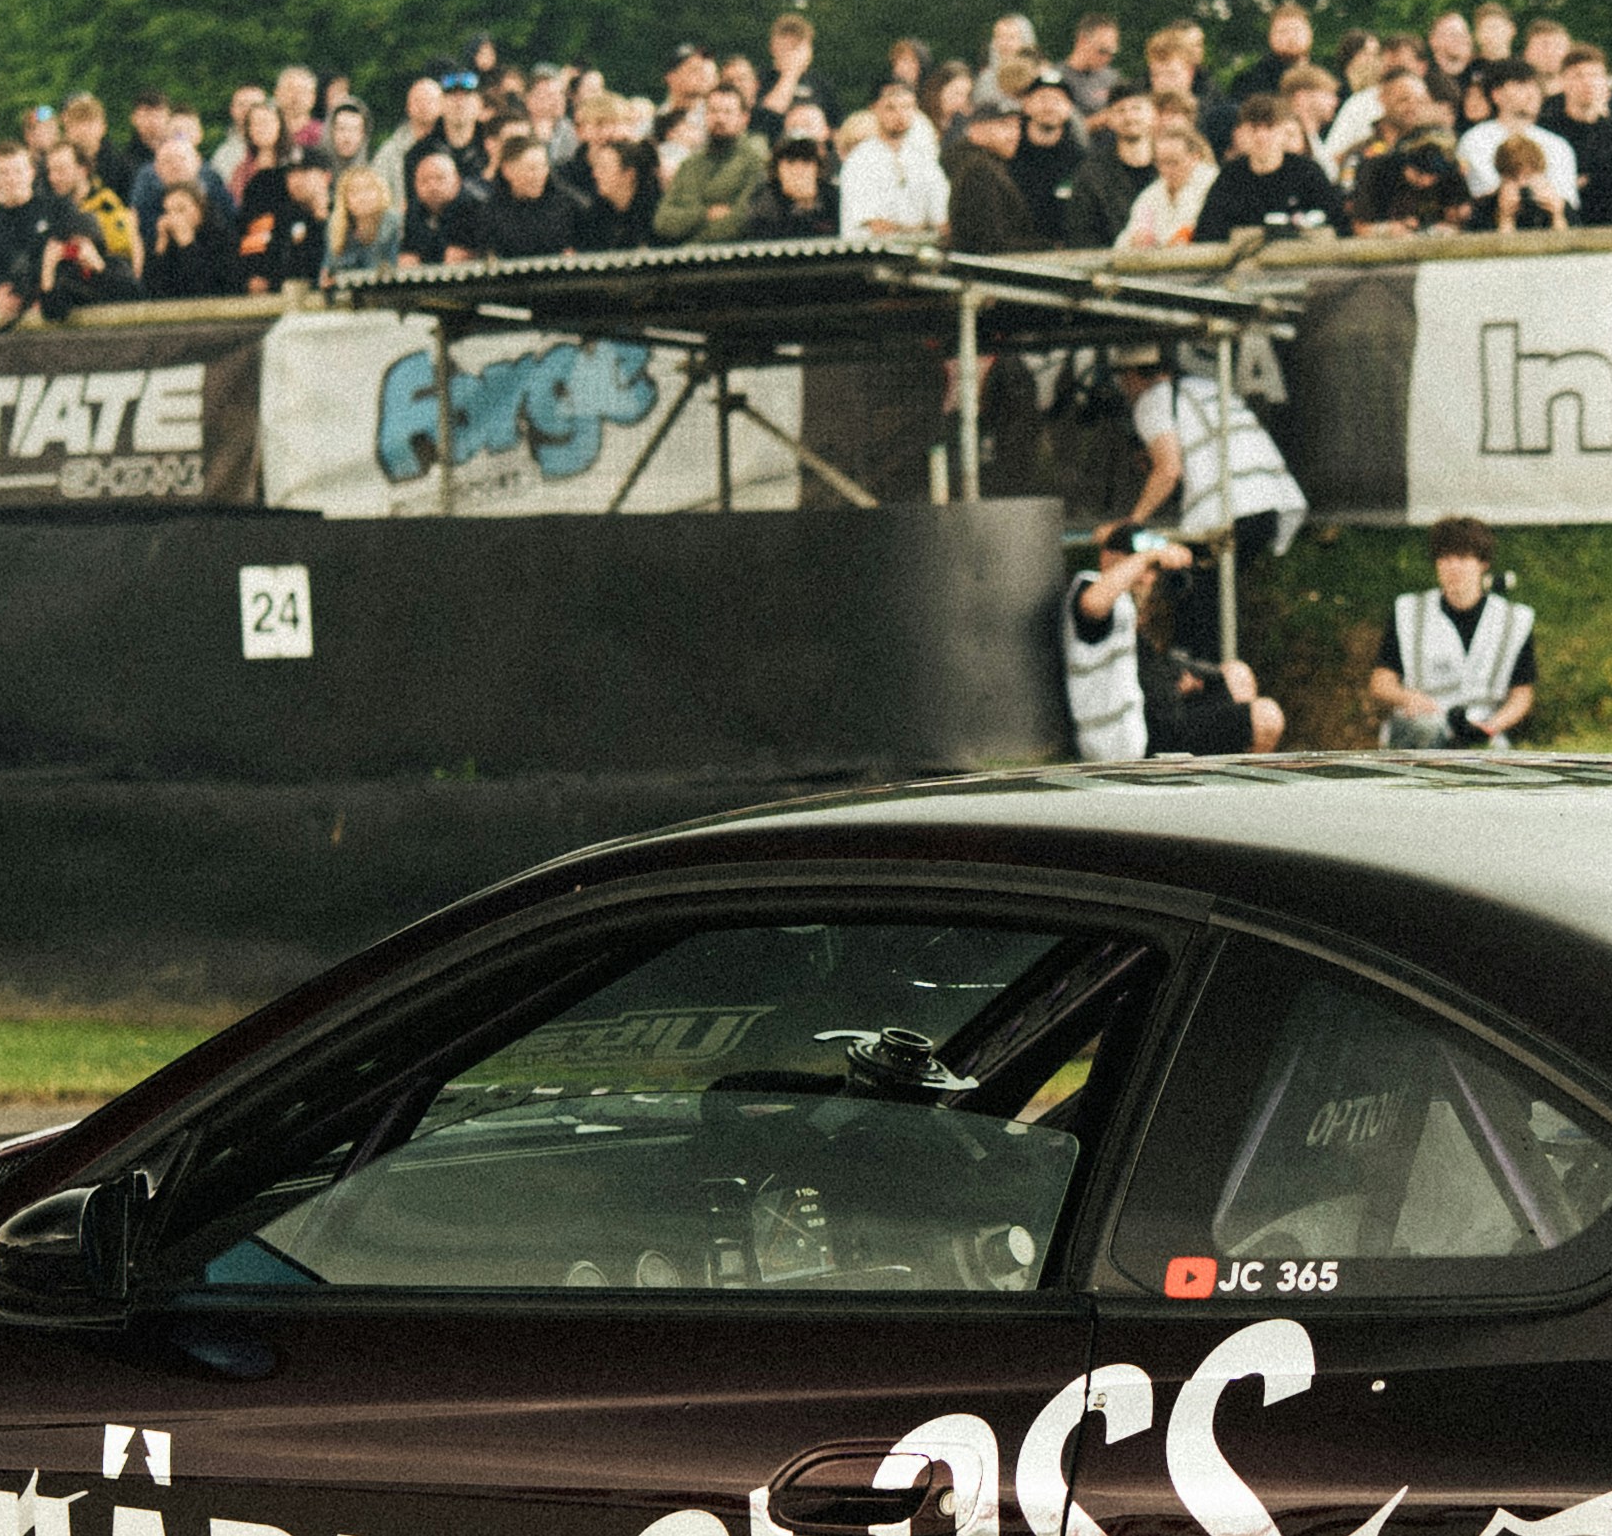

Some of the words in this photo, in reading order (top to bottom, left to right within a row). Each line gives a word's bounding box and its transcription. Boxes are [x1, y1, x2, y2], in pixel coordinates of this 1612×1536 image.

[251, 590, 300, 633] 24
[1218, 1261, 1265, 1292] JC
[1276, 1261, 1339, 1292] 365
